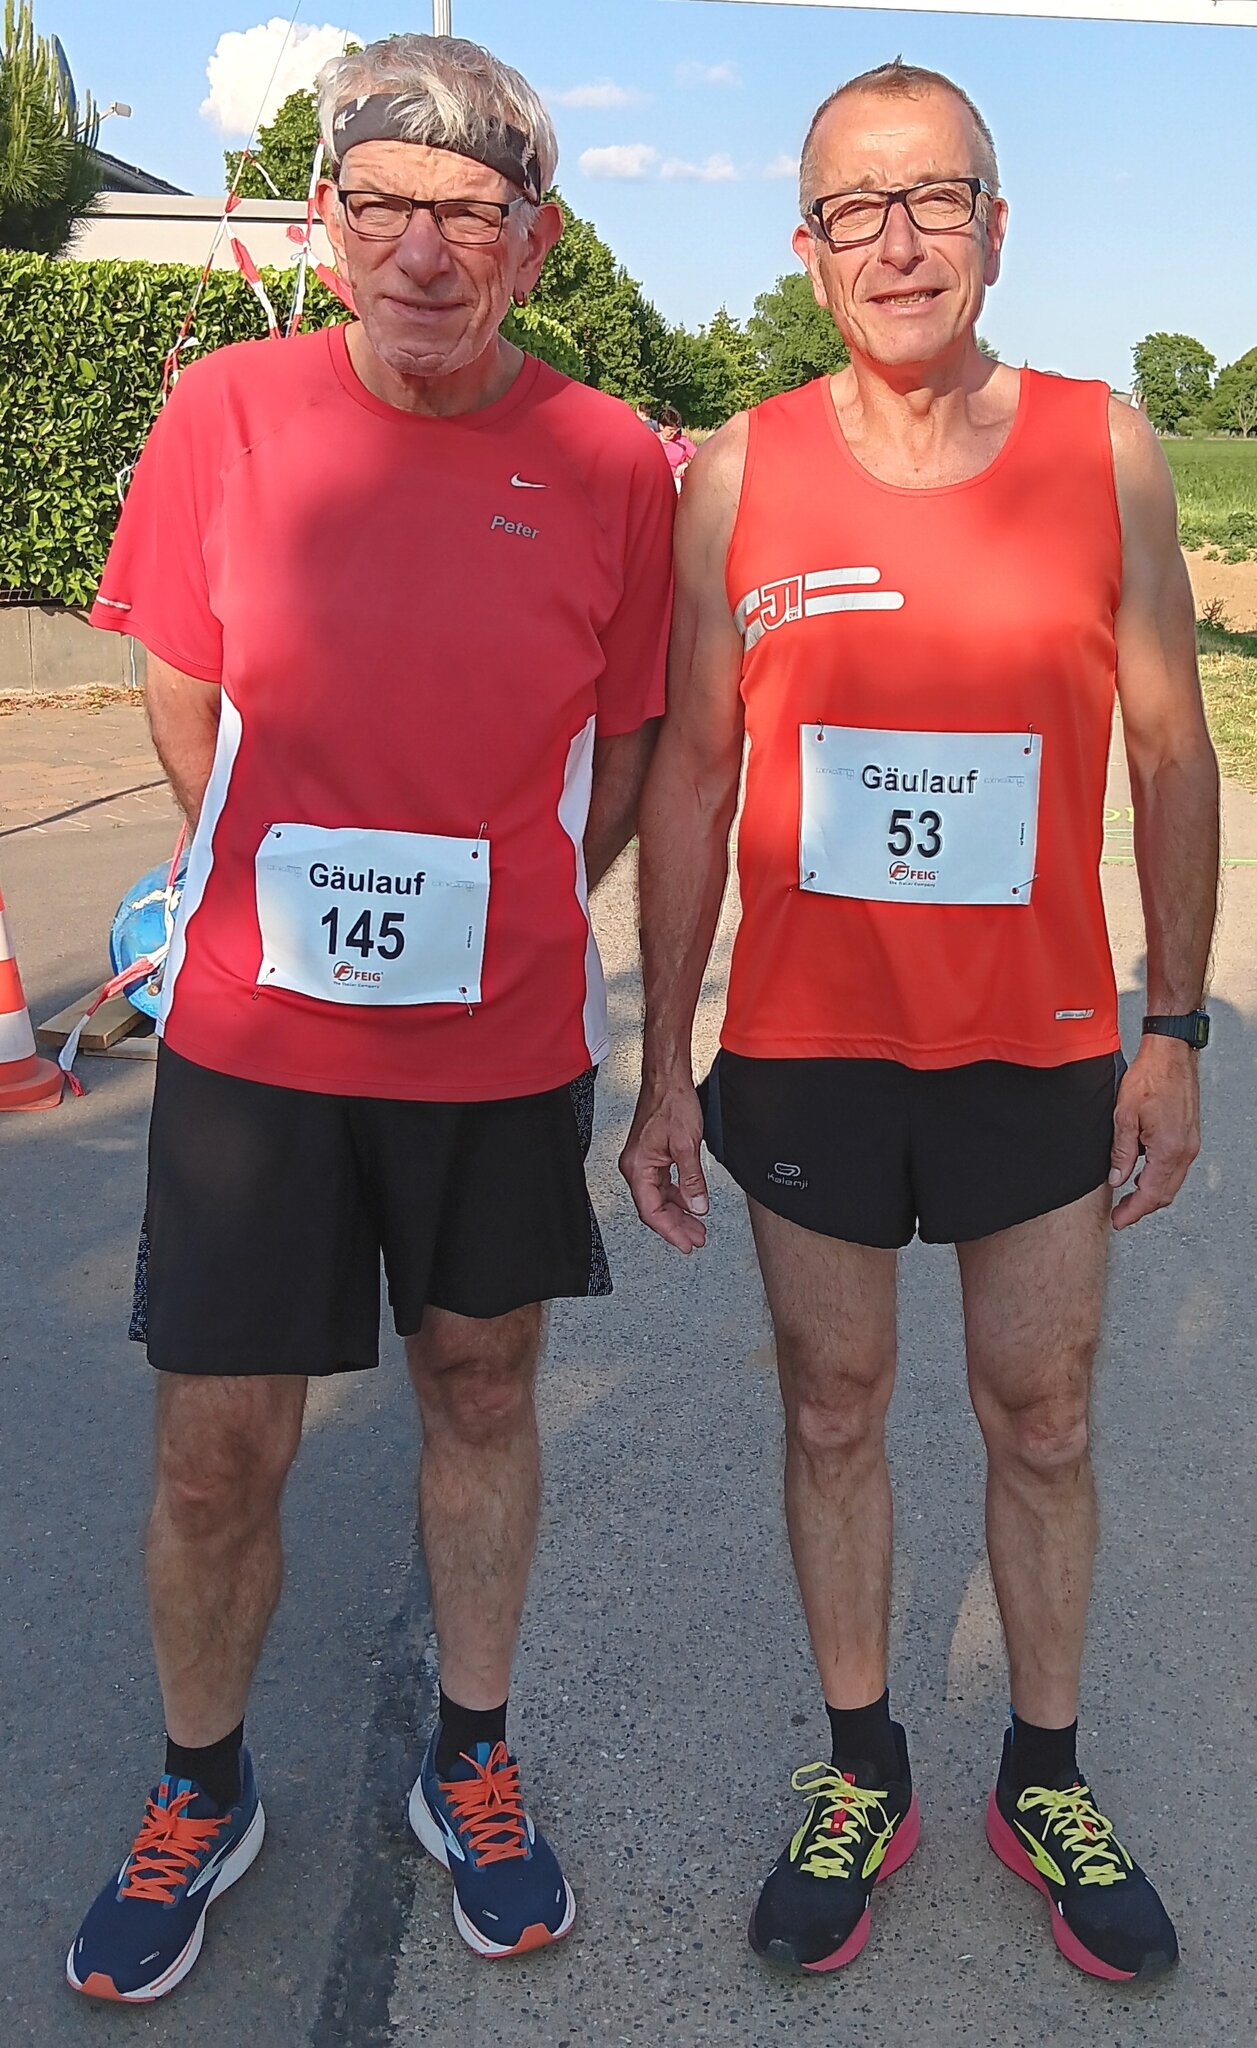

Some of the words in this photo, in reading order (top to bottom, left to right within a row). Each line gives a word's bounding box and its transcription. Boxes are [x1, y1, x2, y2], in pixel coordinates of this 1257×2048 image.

[490, 514, 540, 539] Peter
[861, 764, 979, 794] Gäulauf
[887, 808, 943, 858] 53
[308, 862, 427, 896] Gäulauf
[910, 870, 936, 880] FEIG
[321, 906, 405, 960] 145
[354, 971, 381, 982] FEIG
